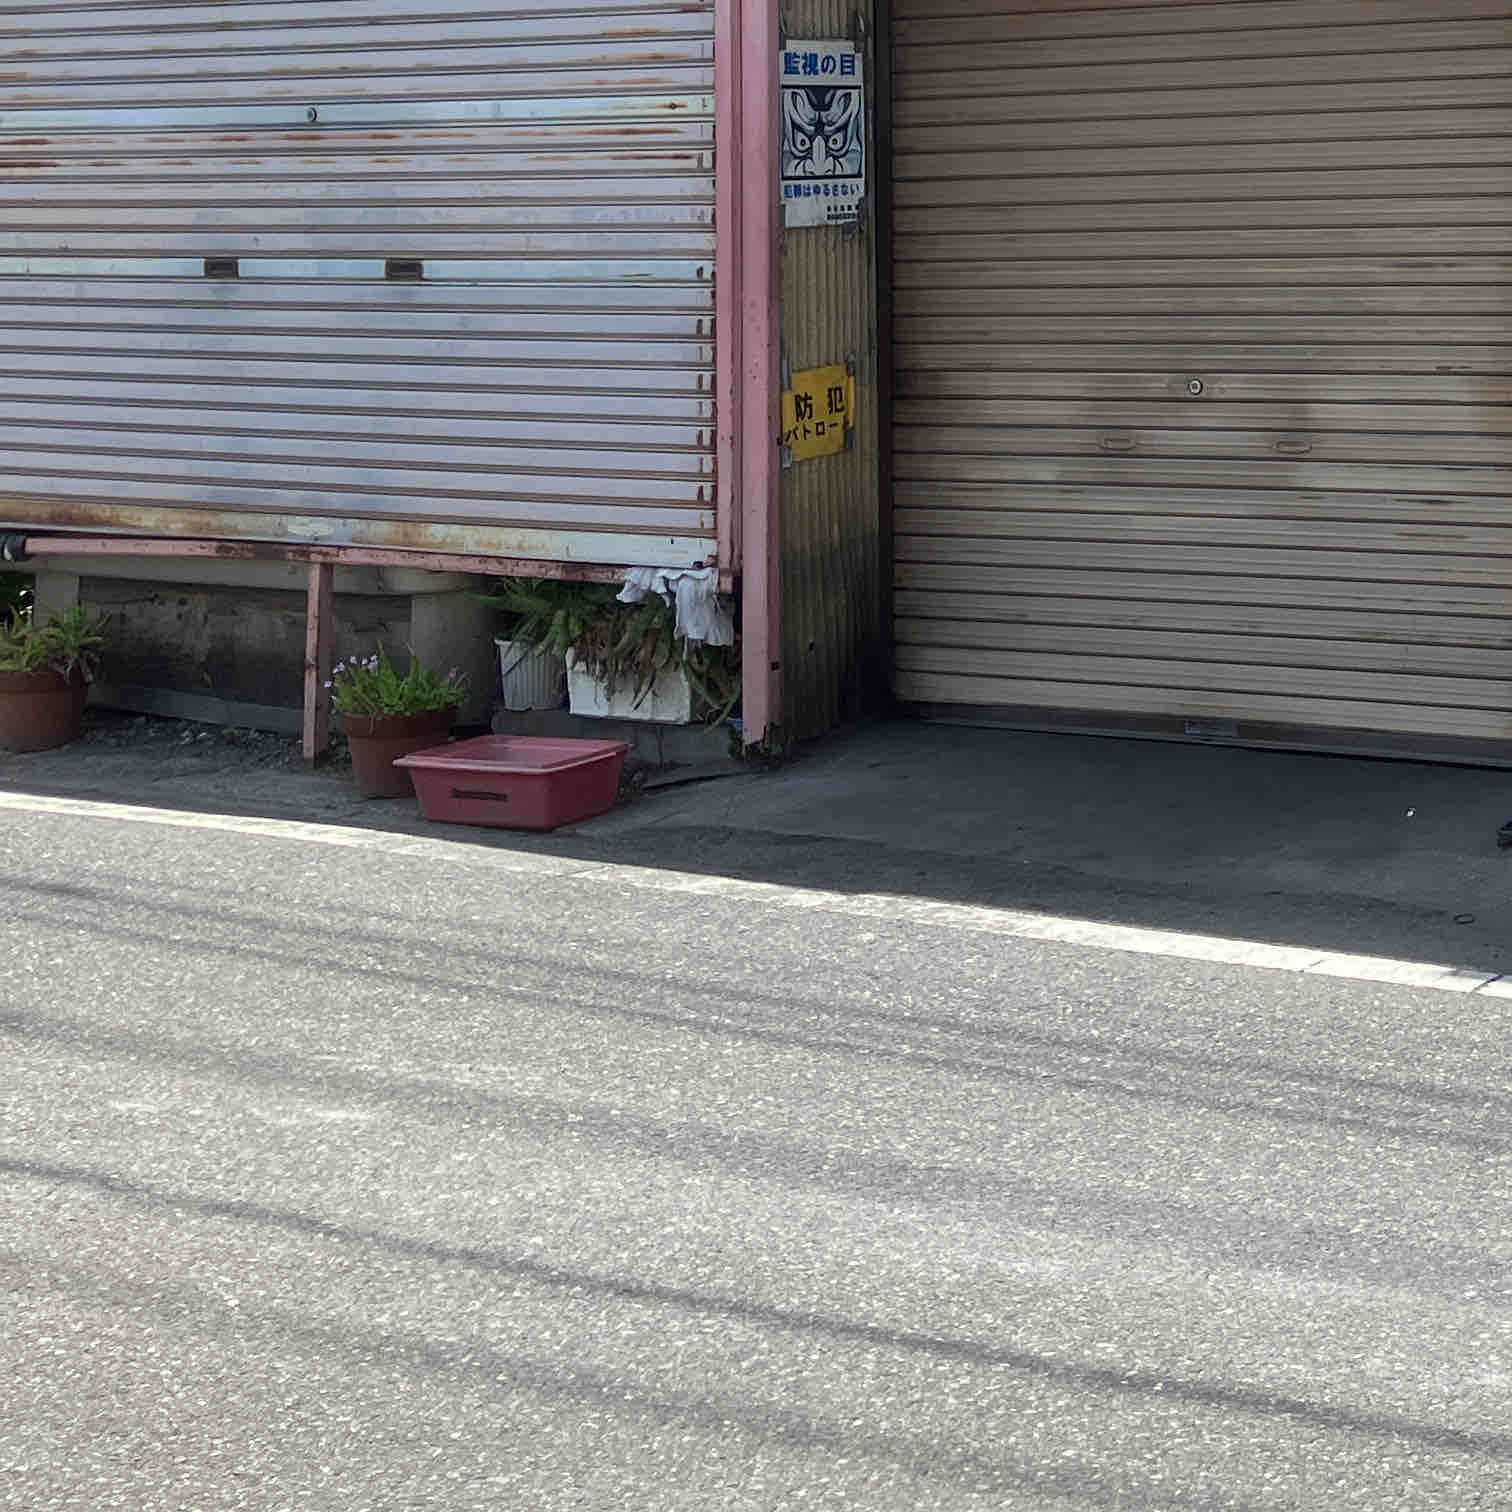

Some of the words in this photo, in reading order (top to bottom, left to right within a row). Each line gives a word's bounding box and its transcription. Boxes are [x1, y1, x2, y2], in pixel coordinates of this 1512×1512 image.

[784, 51, 856, 76] 監視の目
[794, 384, 845, 423] 防犯
